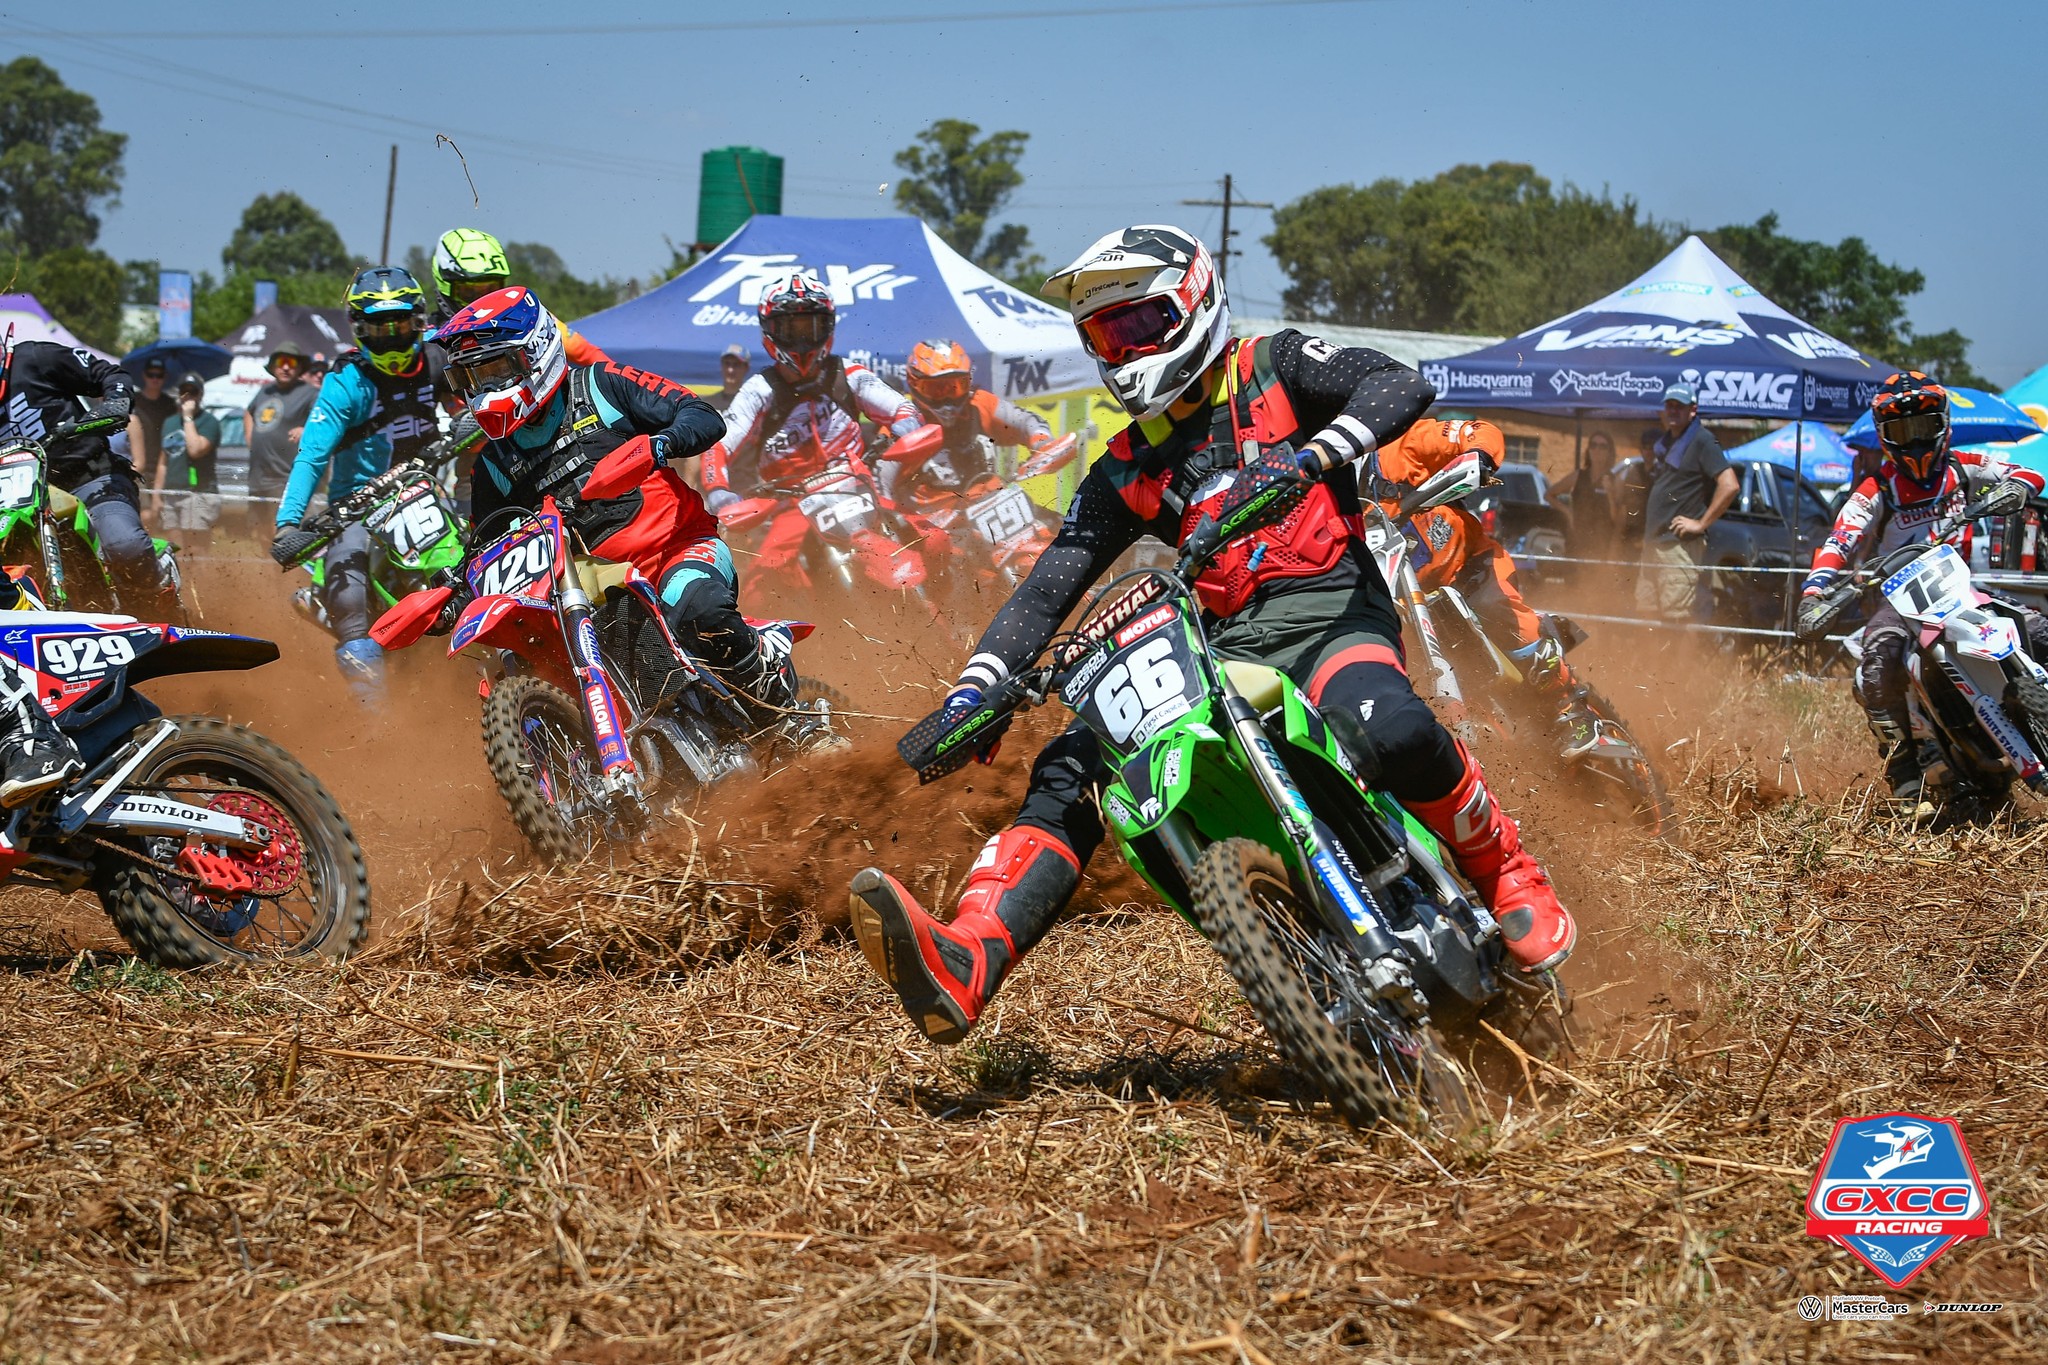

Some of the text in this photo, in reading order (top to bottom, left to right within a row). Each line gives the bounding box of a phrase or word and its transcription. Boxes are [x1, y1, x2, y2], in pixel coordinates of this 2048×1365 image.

[1535, 324, 1743, 351] VANS
[1003, 356, 1054, 397] TRAX
[1451, 370, 1533, 388] Husqvarna
[1699, 371, 1798, 403] SSMG
[384, 494, 445, 555] 715
[1219, 488, 1279, 537] ACERBIS
[482, 534, 556, 597] 420
[1903, 559, 1955, 614] 12
[1120, 609, 1172, 644] MOTUL
[42, 636, 136, 675] 929
[1064, 650, 1104, 695] PEPSON
[1068, 656, 1109, 702] PLASTICS
[1094, 637, 1185, 744] 66
[587, 686, 613, 735] MOTUL
[935, 708, 995, 756] ACERBIS
[1142, 712, 1162, 732] First
[1978, 705, 2019, 760] WHITE STAR
[121, 801, 208, 822] DUNLOP
[1331, 838, 1364, 885] Cables
[1316, 858, 1364, 920] MICHELIN
